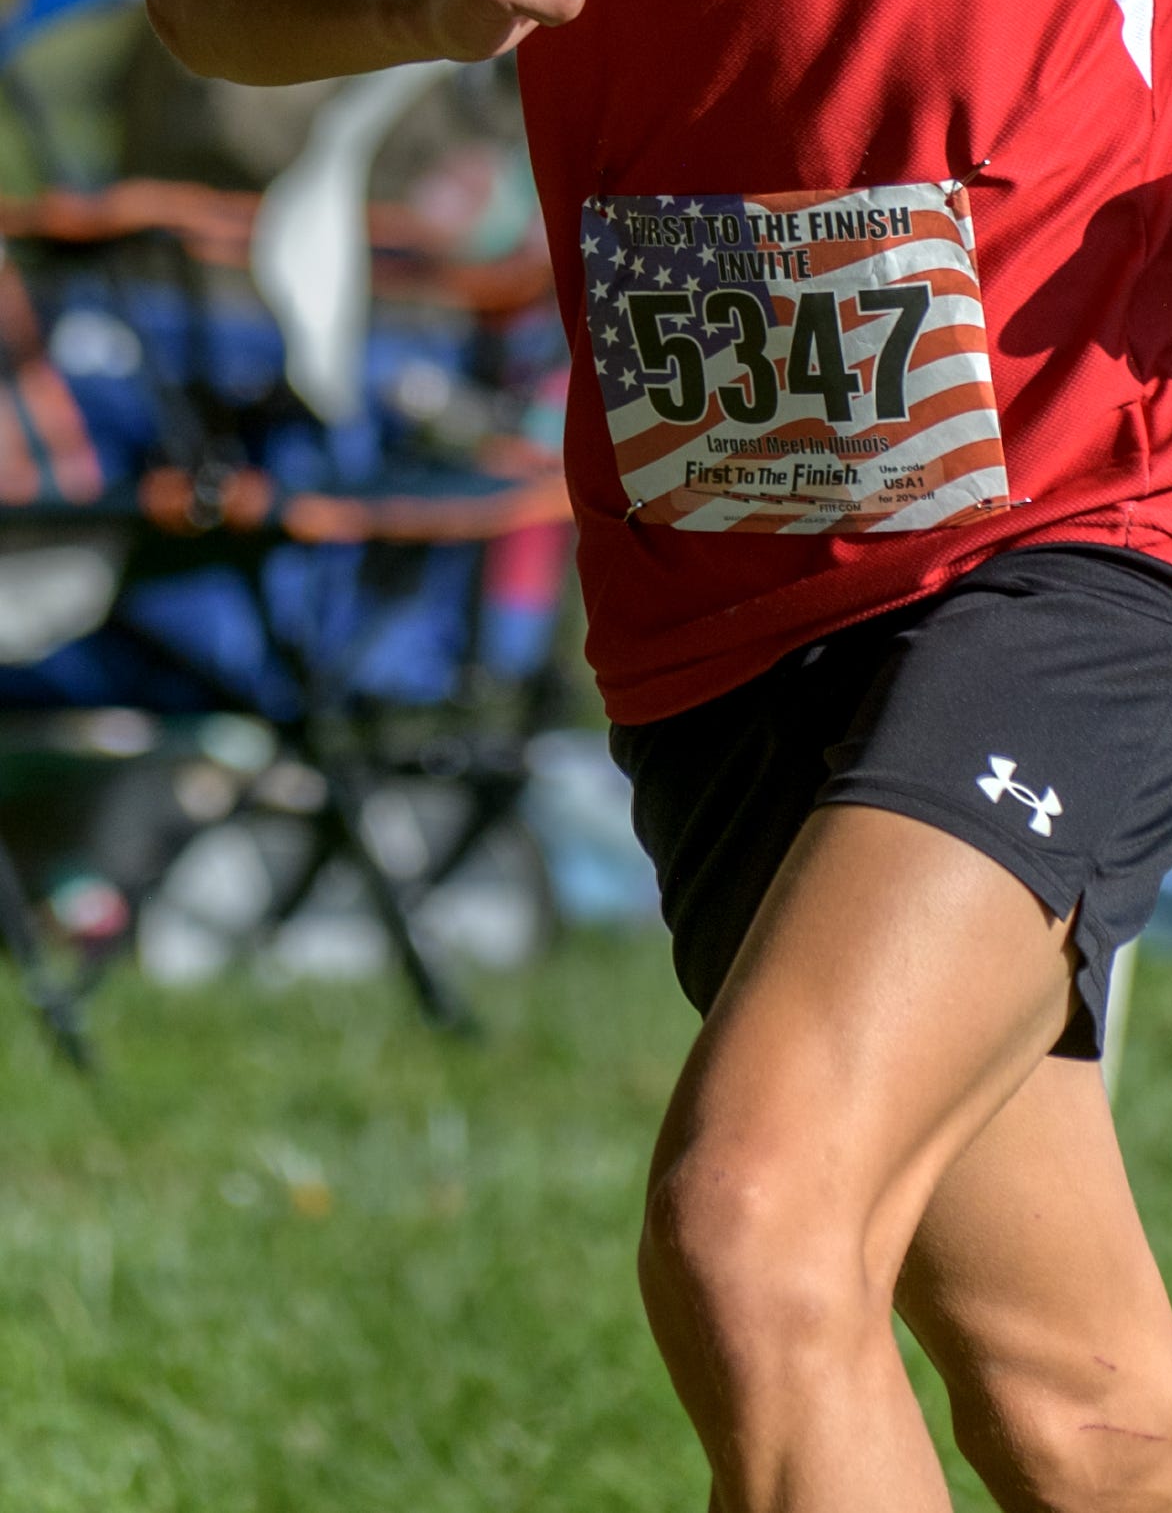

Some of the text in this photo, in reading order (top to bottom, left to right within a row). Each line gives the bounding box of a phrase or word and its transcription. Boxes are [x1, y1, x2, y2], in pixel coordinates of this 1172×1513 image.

[628, 207, 911, 246] FIRST TO THE FINISH
[716, 250, 813, 282] INVITE
[627, 281, 931, 426] 5347
[706, 434, 889, 456] Largest Meet In Illinois
[686, 460, 858, 492] First To The Finish
[879, 463, 925, 474] Use code
[883, 476, 925, 490] USA1
[878, 491, 935, 503] for 20% off
